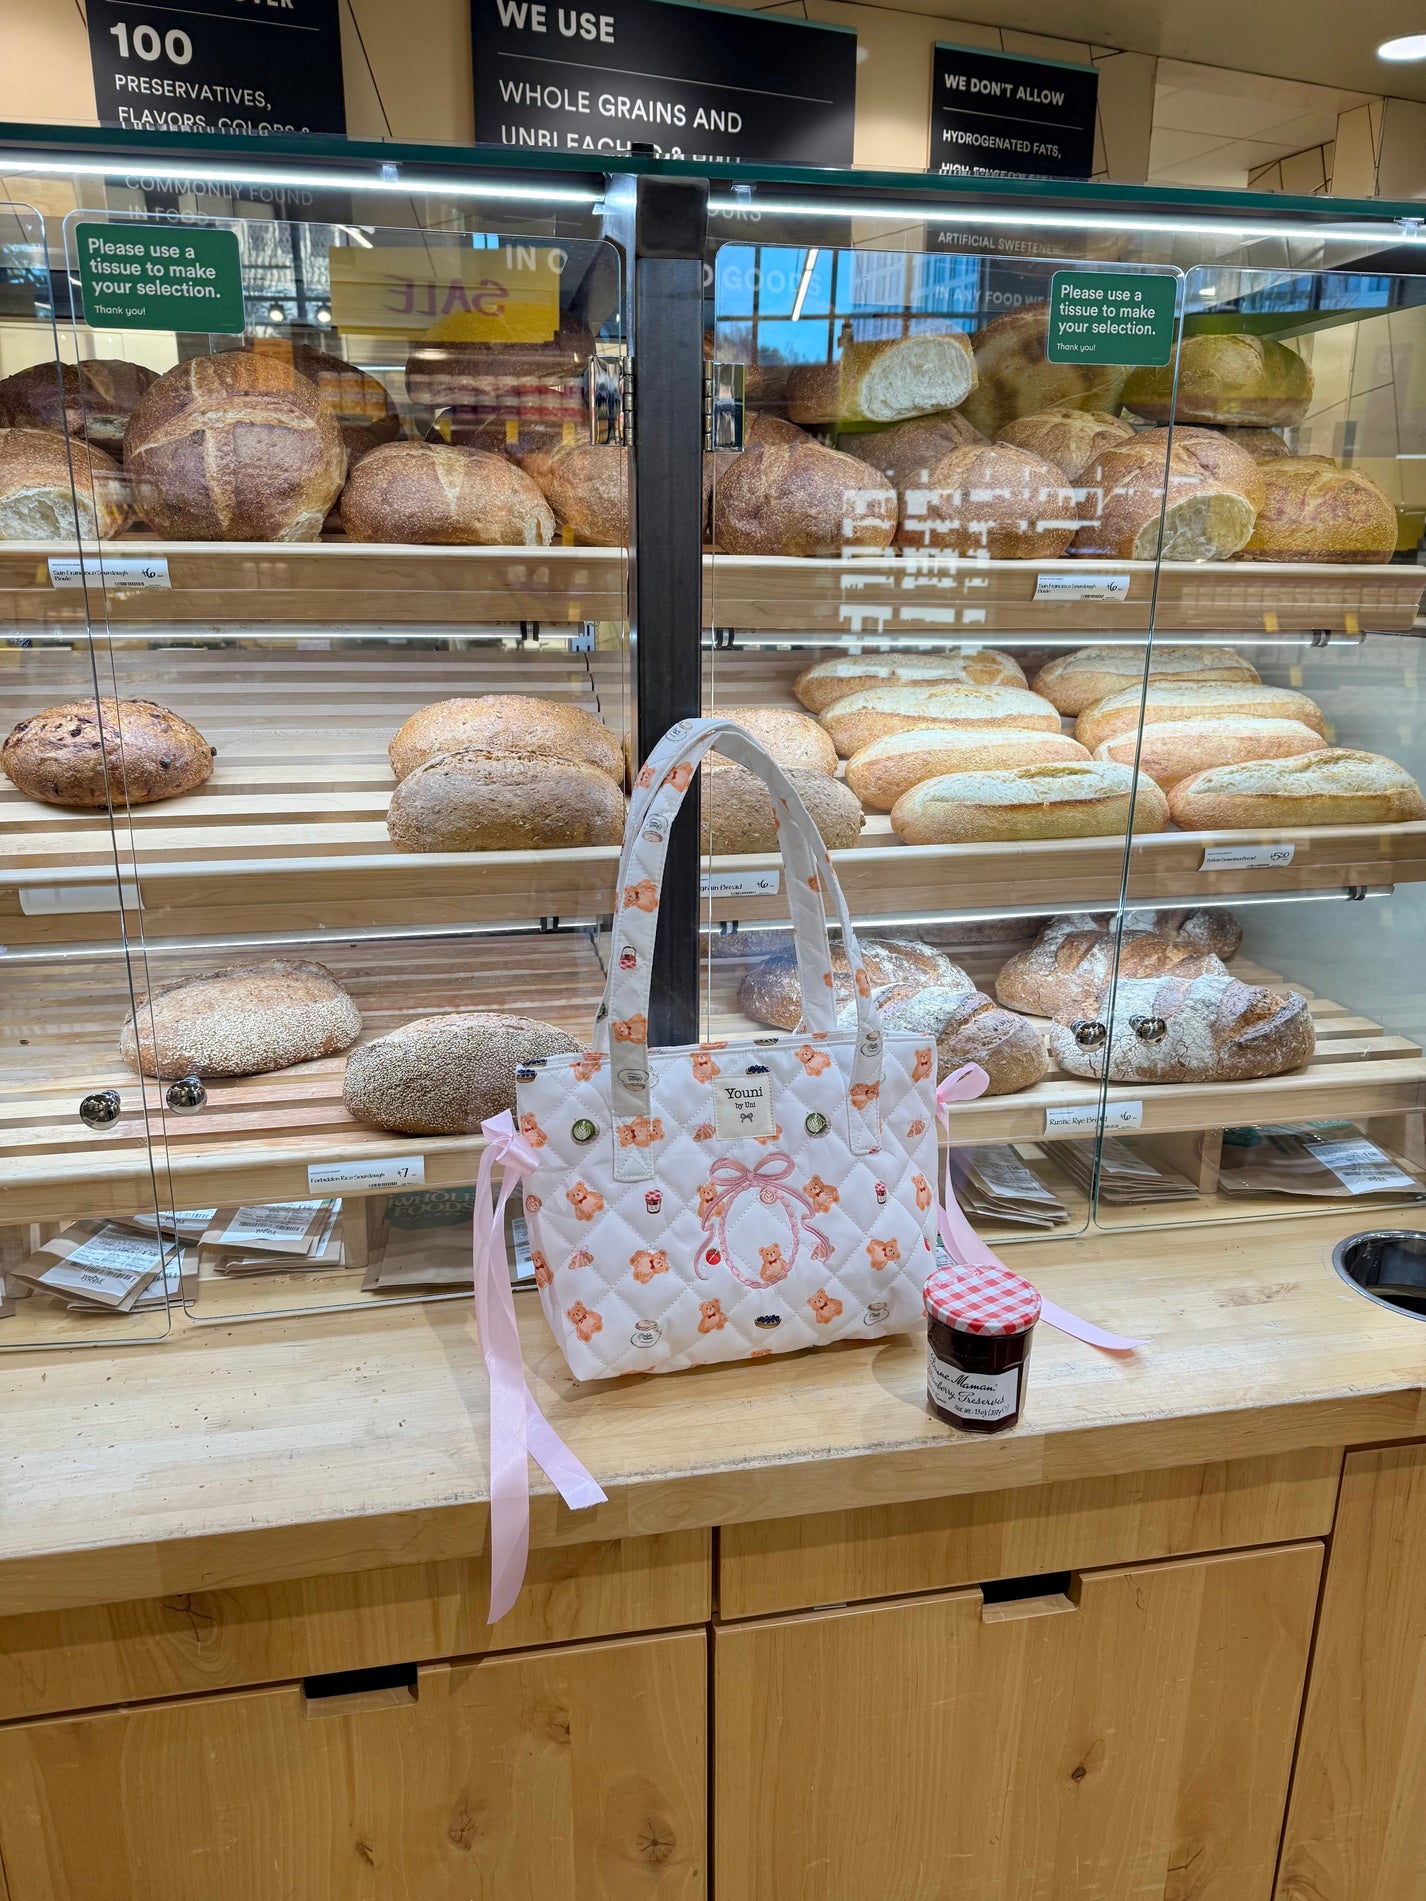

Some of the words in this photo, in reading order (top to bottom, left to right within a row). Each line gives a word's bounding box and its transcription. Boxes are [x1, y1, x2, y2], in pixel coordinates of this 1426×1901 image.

[497, 0, 547, 33] WE
[558, 8, 615, 44] USE
[110, 22, 193, 65] 100
[114, 74, 272, 111] PRESERVATIVES,
[944, 73, 968, 91] WE
[970, 77, 1013, 99] DON'T
[1016, 86, 1065, 106] ALLOW
[499, 79, 591, 114] WHOLE
[598, 94, 687, 126] GRAINS
[693, 108, 743, 134] AND
[942, 129, 1031, 153] HYDROGENATED
[1032, 142, 1062, 159] FATS,
[124, 175, 242, 199] COMMONLY
[250, 187, 314, 206] FOUND
[128, 205, 147, 220] IN
[155, 206, 209, 225] FOOD
[88, 237, 145, 256] Please
[149, 245, 180, 259] use
[184, 247, 196, 259] a
[938, 231, 996, 249] ARTIFICIAL
[506, 244, 537, 272] IN
[89, 258, 142, 276] tissue
[145, 261, 165, 277] to
[169, 263, 217, 279] make
[91, 280, 133, 296] your
[136, 280, 222, 298] selection.
[985, 290, 1022, 306] FOOD
[1060, 284, 1104, 300] Please
[1107, 290, 1131, 301] use
[1134, 291, 1142, 302] a
[94, 305, 124, 315] Thank
[125, 307, 147, 317] you!
[1059, 301, 1099, 317] tissue
[1102, 304, 1116, 317] to
[1119, 304, 1156, 318] make
[1058, 321, 1089, 335] your
[1091, 320, 1156, 335] selection.
[1056, 342, 1079, 351] Thank
[1079, 344, 1096, 353] you!
[719, 883, 743, 891] Bread
[725, 1087, 763, 1099] Youni
[735, 1102, 744, 1110] by
[1072, 1117, 1086, 1126] Rye
[310, 1175, 340, 1184] Forbidden
